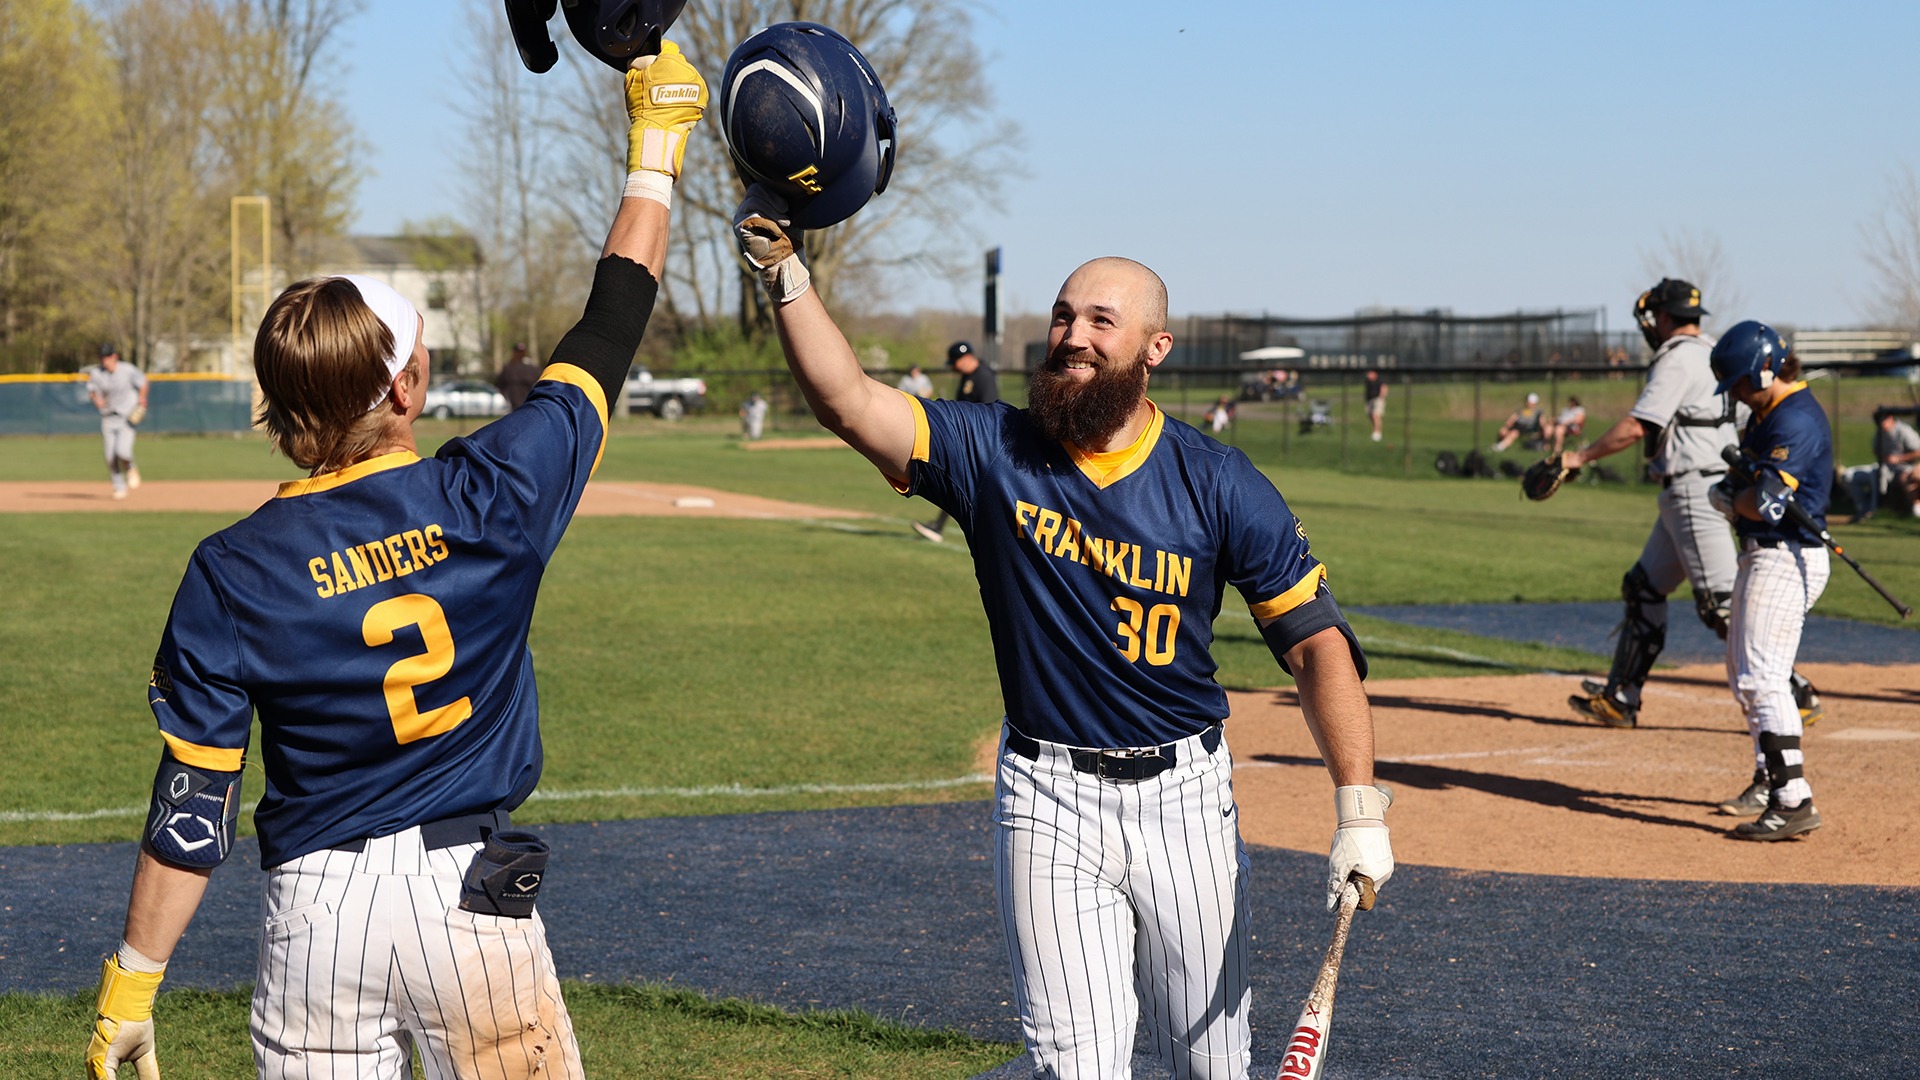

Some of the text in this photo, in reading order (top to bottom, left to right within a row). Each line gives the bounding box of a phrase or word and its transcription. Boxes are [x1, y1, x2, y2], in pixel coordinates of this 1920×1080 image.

[308, 523, 449, 599] SANDERS
[1015, 500, 1192, 597] FRANKLIN
[361, 593, 473, 745] 2
[1110, 596, 1181, 666] 30
